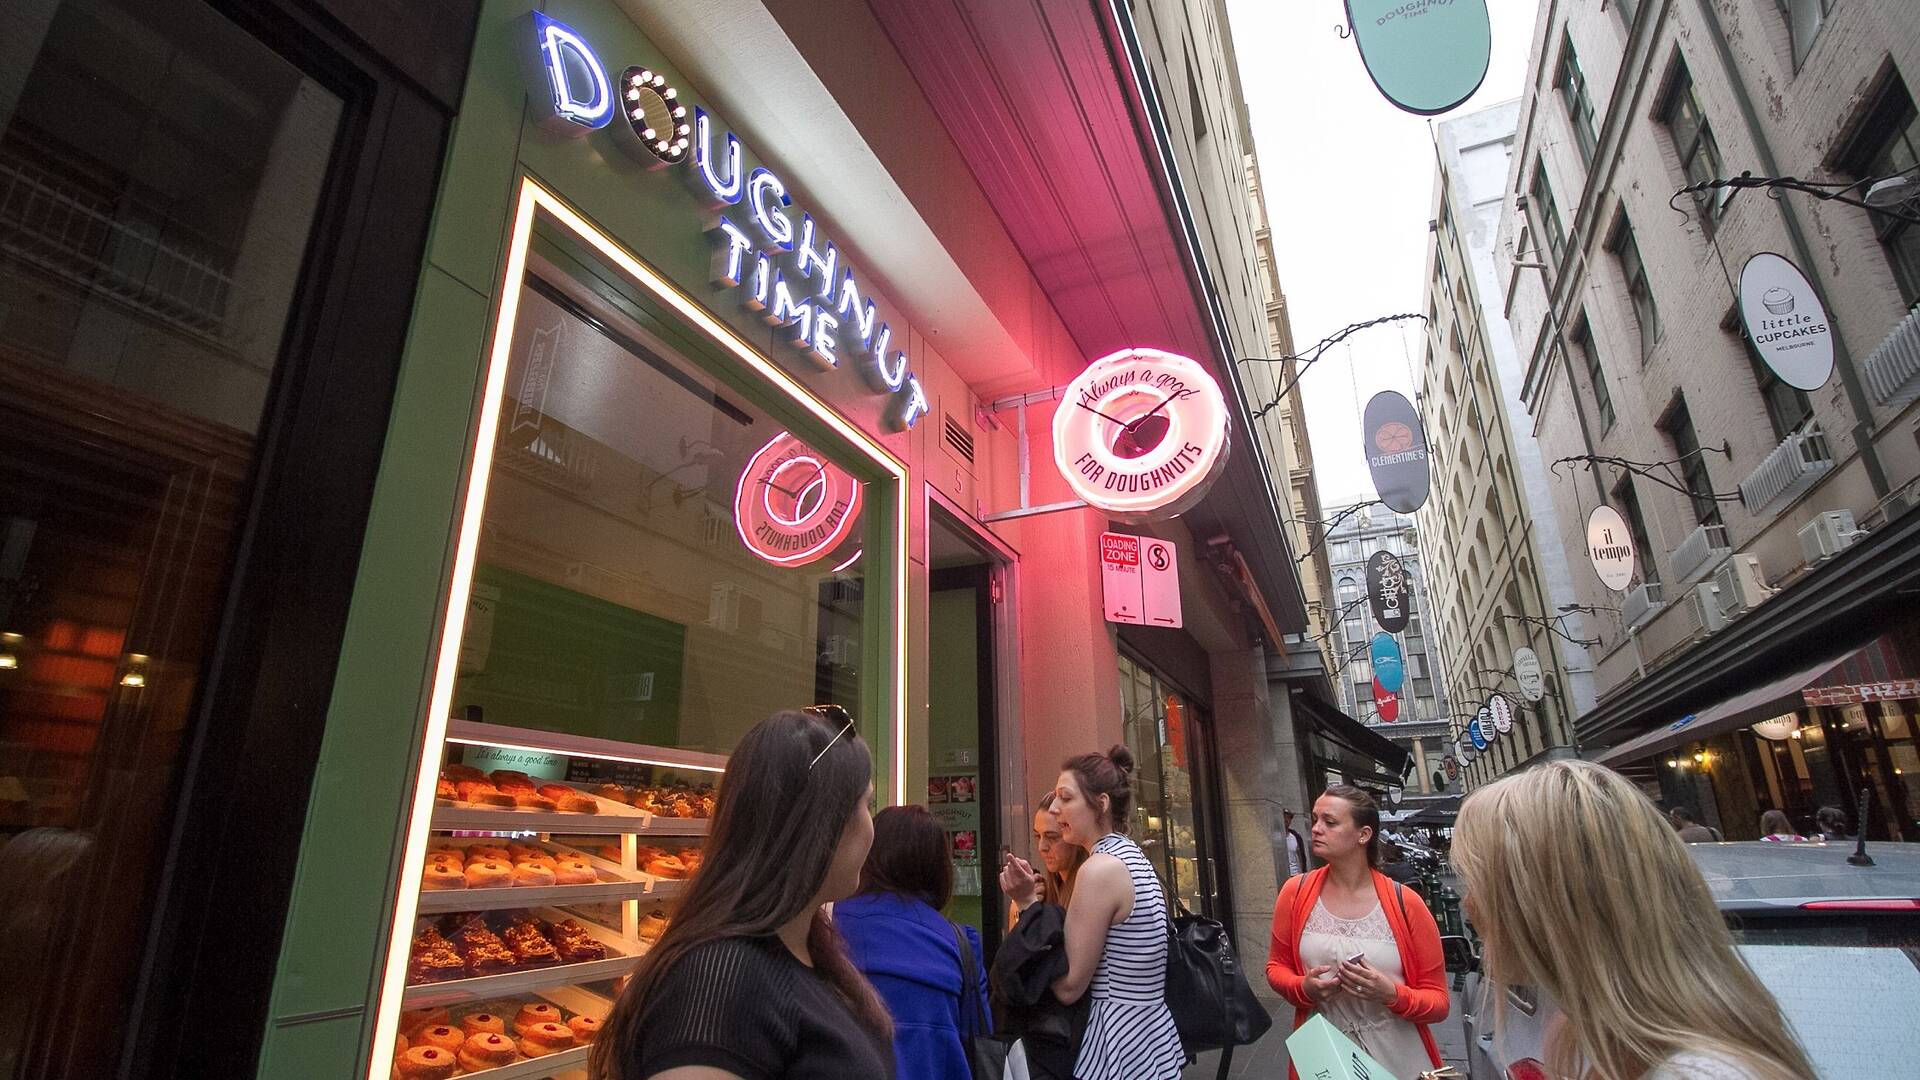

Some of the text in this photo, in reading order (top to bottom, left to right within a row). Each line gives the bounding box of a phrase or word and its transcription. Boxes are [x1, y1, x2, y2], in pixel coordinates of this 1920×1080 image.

[532, 10, 929, 430] DOUGHNUT
[716, 215, 839, 371] TIME
[1762, 314, 1811, 330] little
[1756, 324, 1826, 344] CUPCAKES
[1776, 341, 1814, 351] MELBOURNE
[1081, 369, 1200, 408] Always a good
[1371, 449, 1424, 467] CLEMENTINE'S
[1074, 442, 1202, 492] FOR DOUGHNUTS
[1603, 528, 1613, 544] il
[1103, 538, 1137, 552] LOADING
[1592, 545, 1631, 562] tempo
[1106, 549, 1136, 563] ZONE
[1115, 565, 1136, 573] MINUTE
[491, 749, 516, 765] always
[524, 755, 543, 767] good
